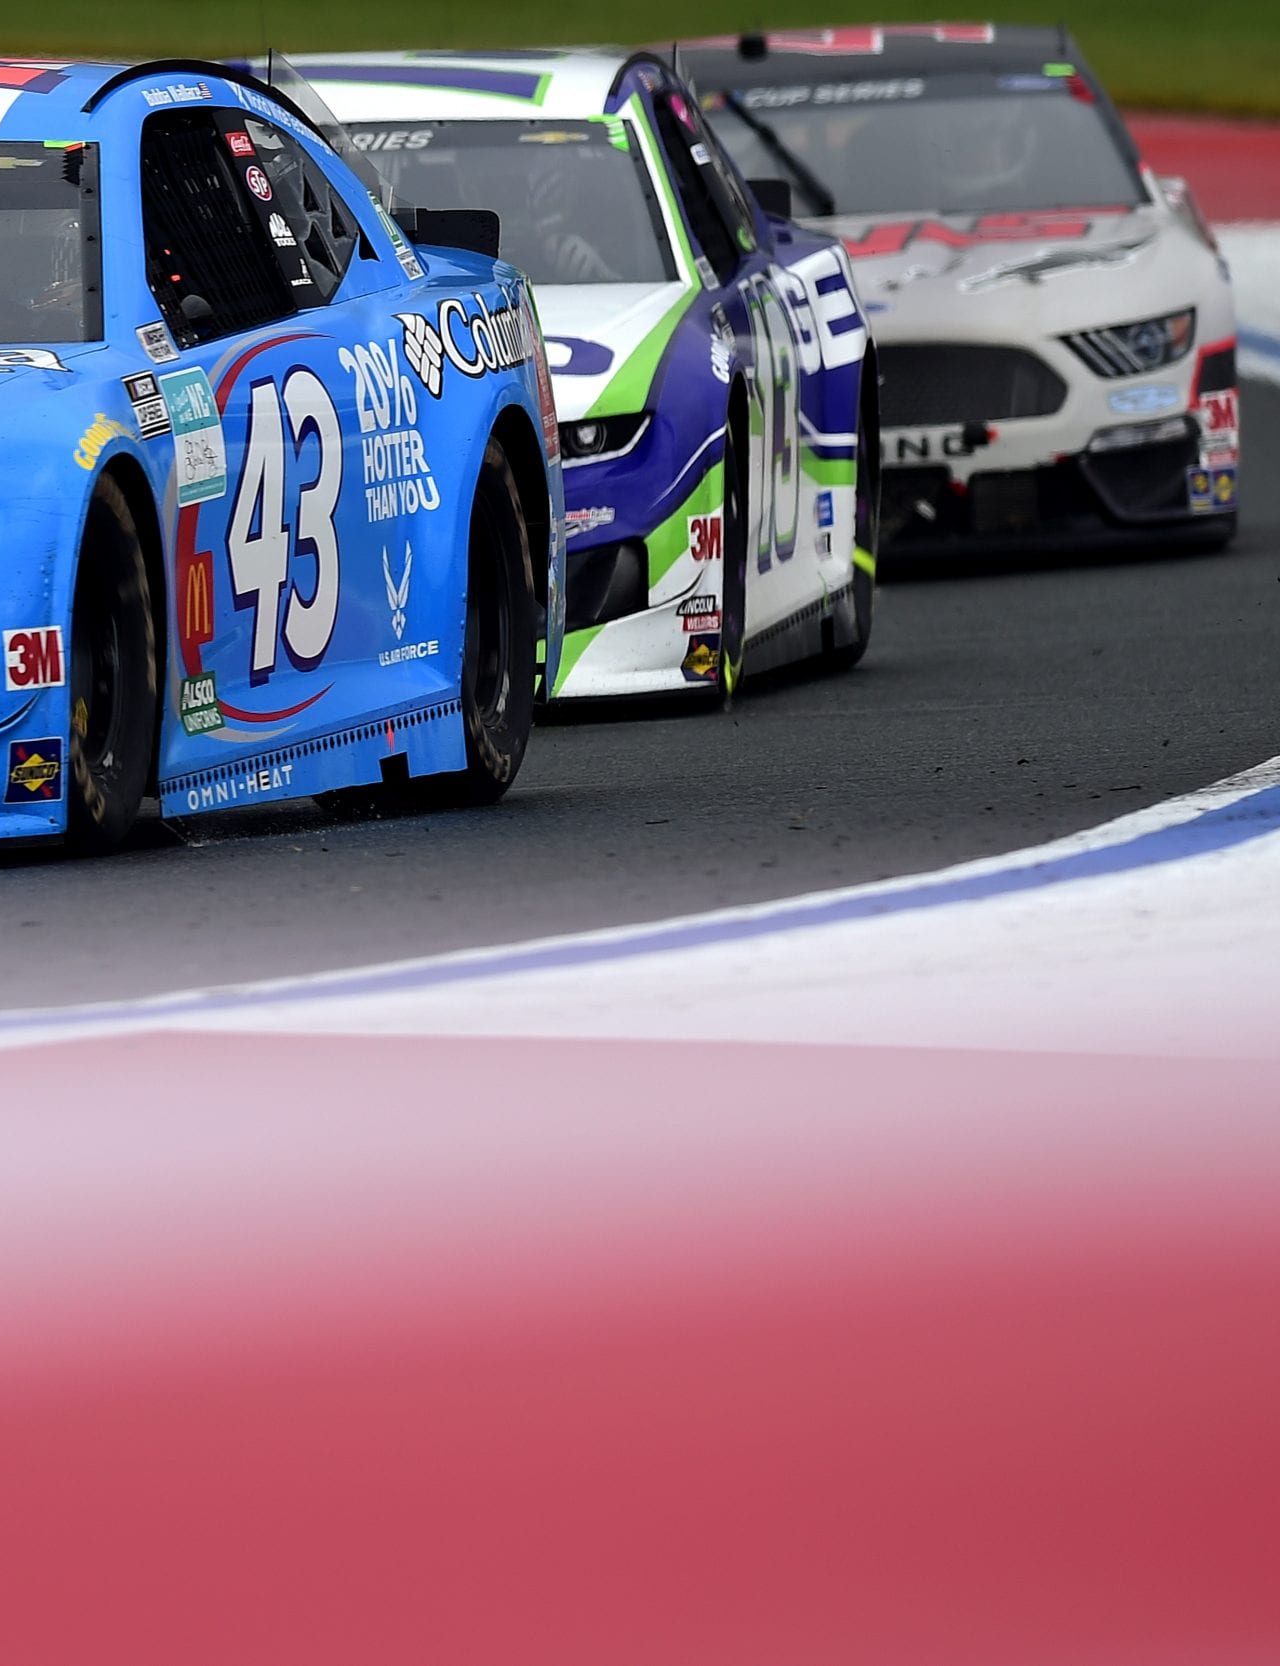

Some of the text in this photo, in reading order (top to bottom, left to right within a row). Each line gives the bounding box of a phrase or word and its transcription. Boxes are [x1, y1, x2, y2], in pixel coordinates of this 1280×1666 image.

[351, 129, 434, 152] RIES
[248, 169, 270, 197] STP
[338, 338, 417, 433] 20%
[362, 429, 431, 484] HOTTER
[224, 362, 344, 682] 43
[365, 476, 441, 523] THAN YOU
[690, 517, 721, 562] 3M
[8, 629, 61, 687] 3M
[401, 640, 439, 663] FORCE
[182, 678, 216, 712] ALSCO
[184, 709, 221, 732] UNIFORMS
[187, 764, 294, 811] OMNI-HEAT
